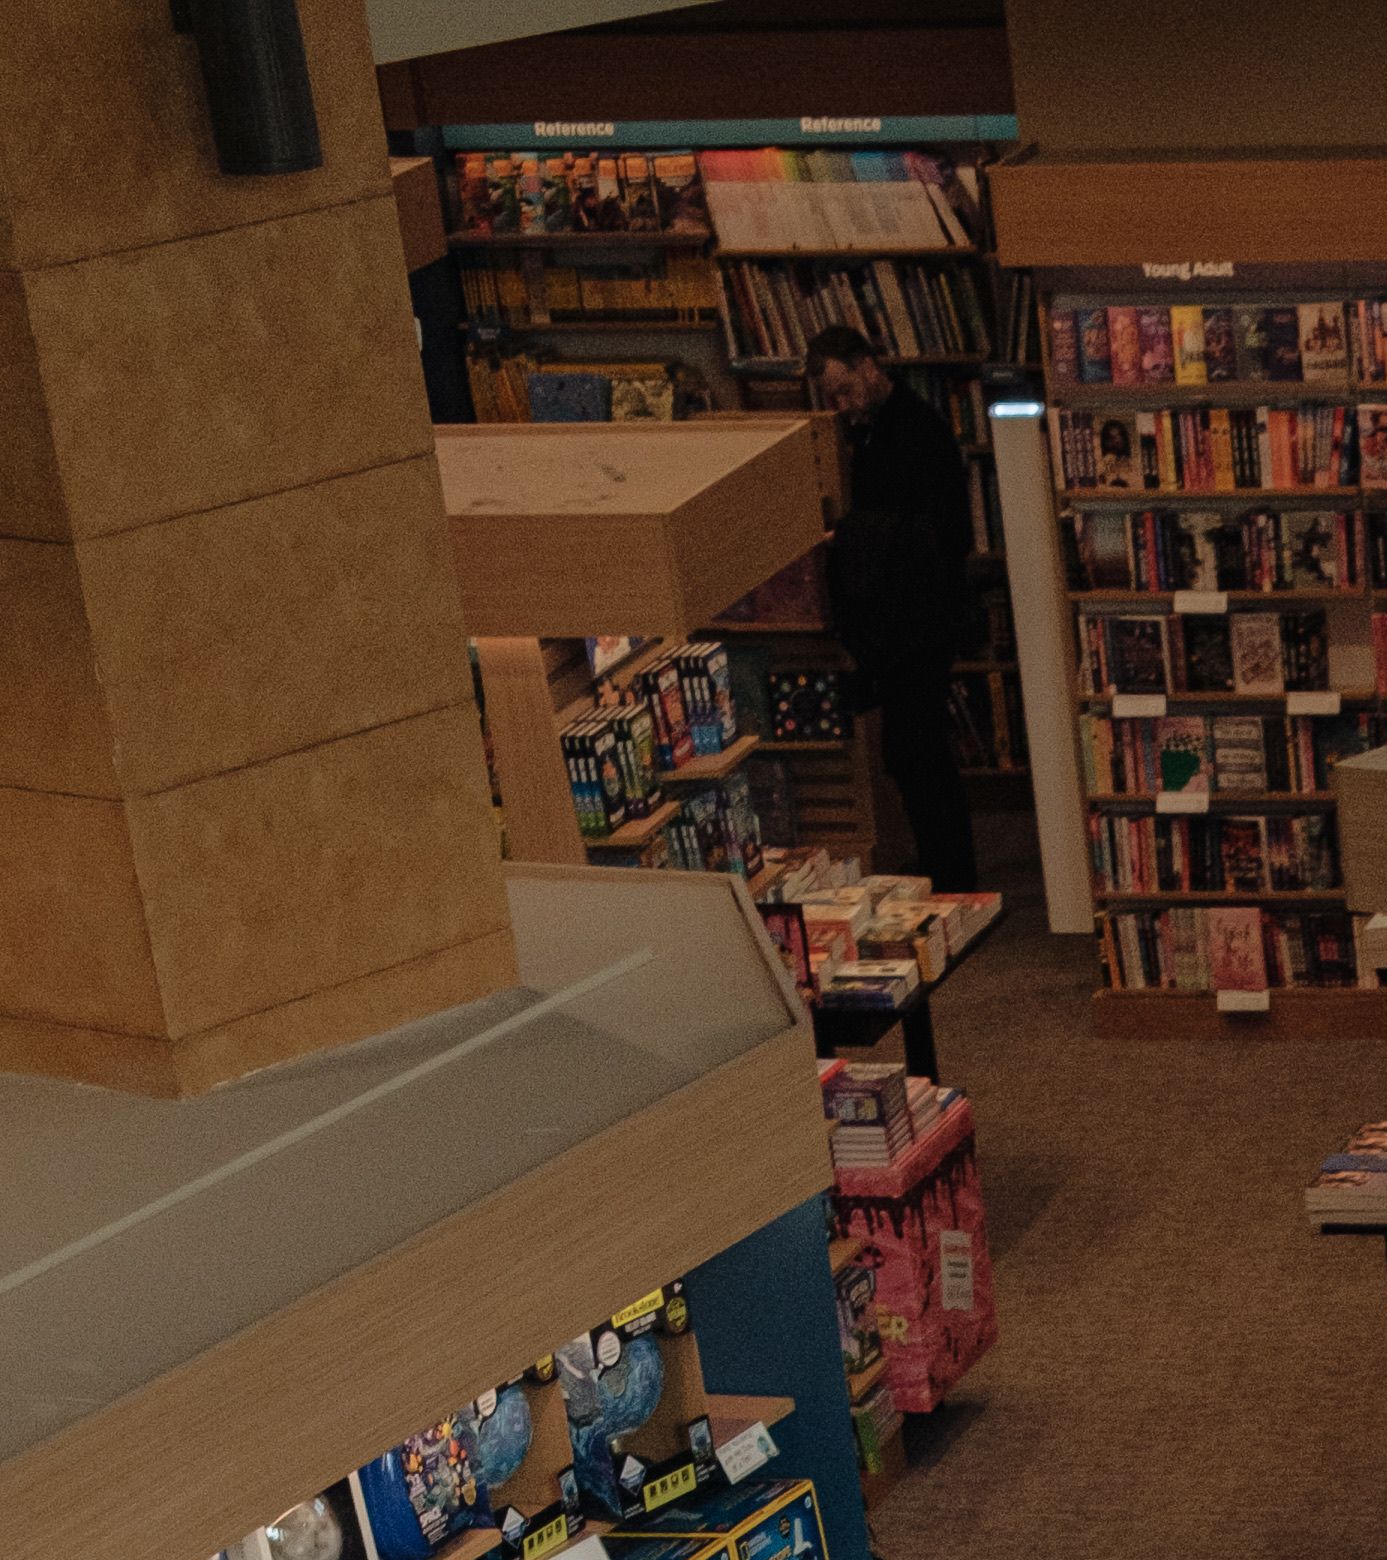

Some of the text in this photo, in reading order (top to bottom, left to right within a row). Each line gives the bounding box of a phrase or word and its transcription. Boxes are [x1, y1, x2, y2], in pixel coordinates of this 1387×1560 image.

[533, 121, 615, 137] Reference
[800, 117, 882, 134] Reference
[1142, 260, 1234, 280] Young Adult
